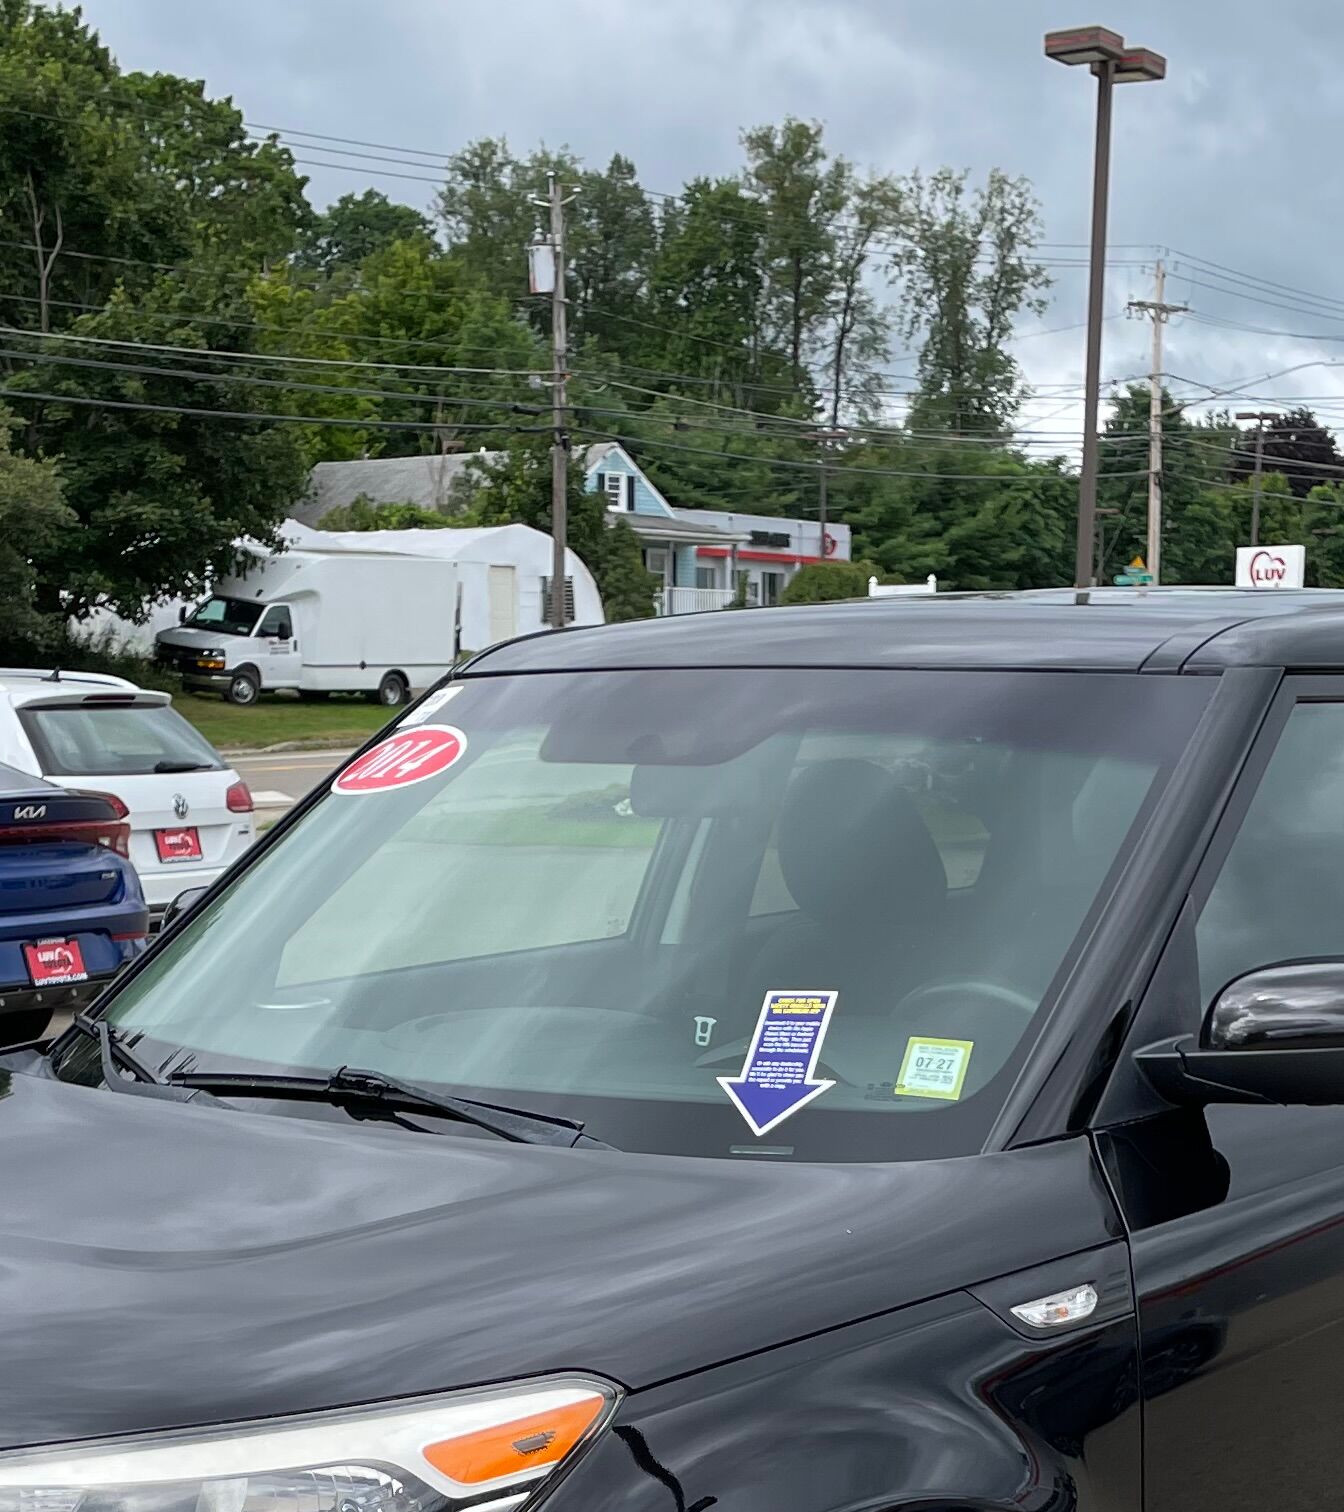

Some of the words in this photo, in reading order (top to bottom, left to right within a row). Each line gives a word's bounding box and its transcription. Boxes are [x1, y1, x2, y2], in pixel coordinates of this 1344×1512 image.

[1256, 568, 1286, 581] LUV
[339, 739, 456, 784] 2014
[14, 805, 47, 819] KIA
[916, 1057, 934, 1069] 07
[936, 1058, 955, 1070] 27
